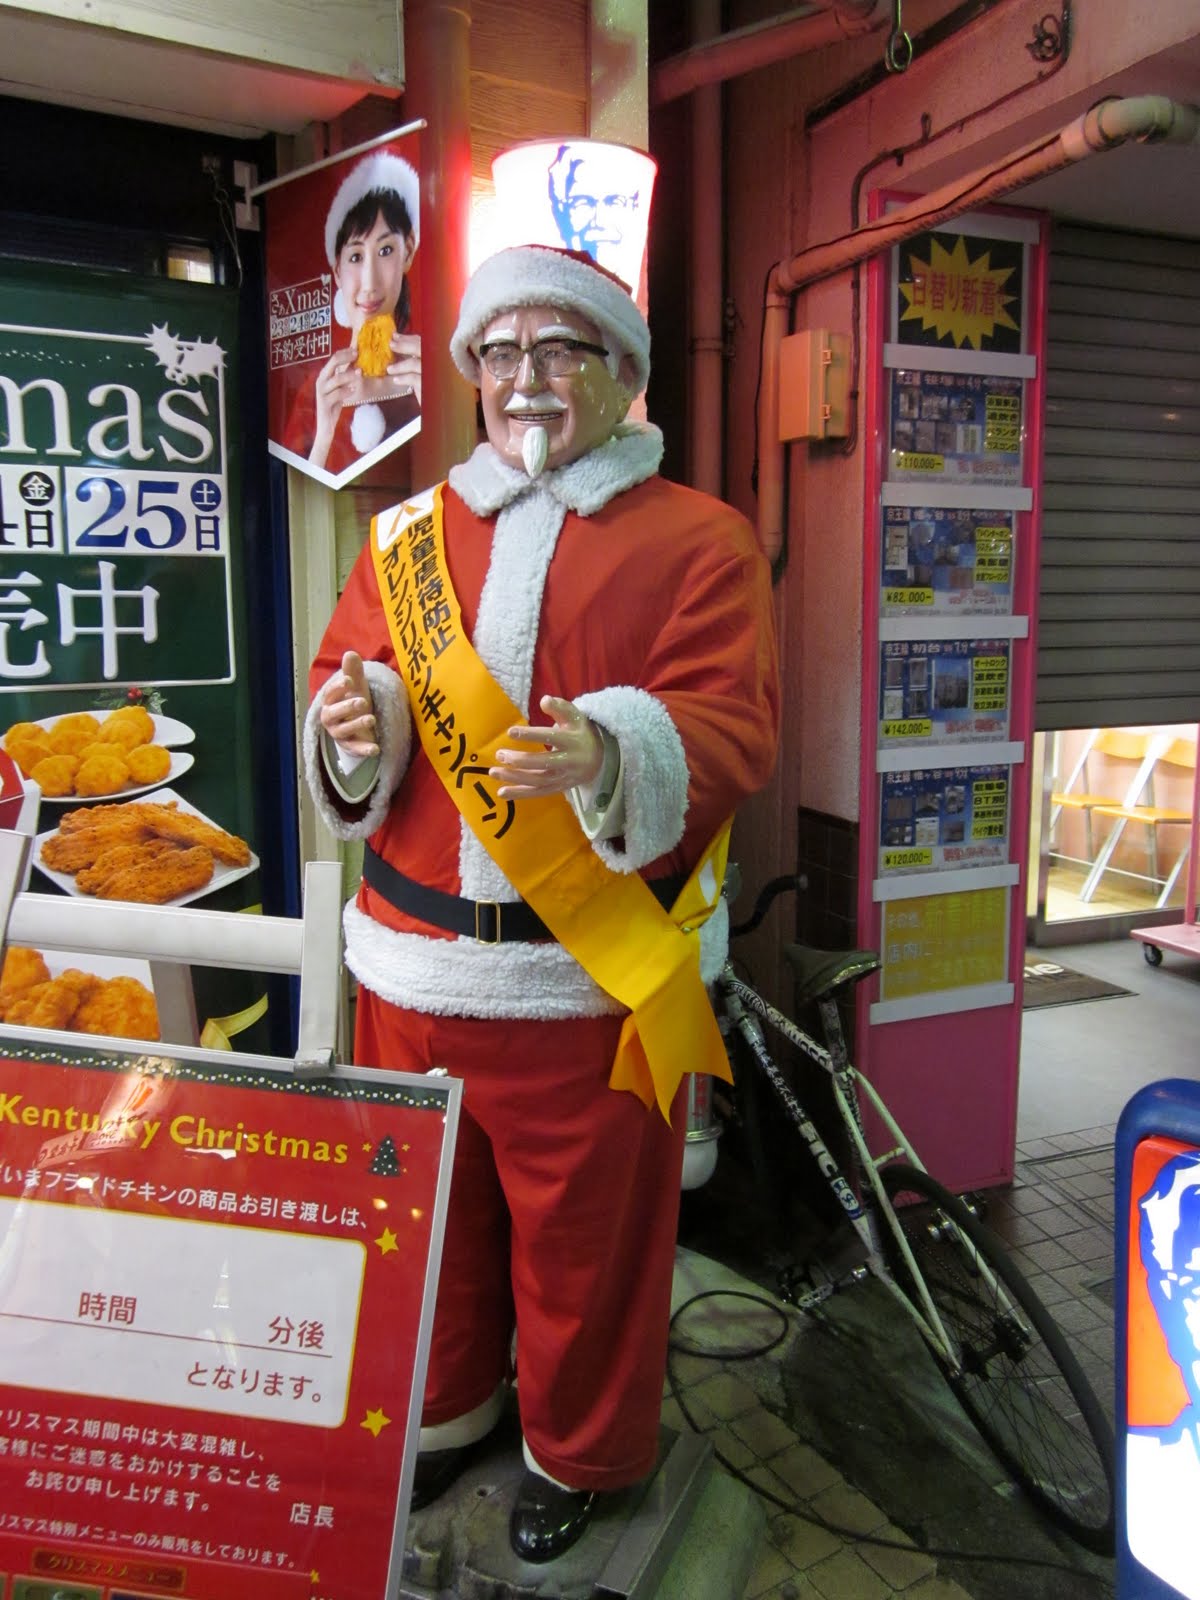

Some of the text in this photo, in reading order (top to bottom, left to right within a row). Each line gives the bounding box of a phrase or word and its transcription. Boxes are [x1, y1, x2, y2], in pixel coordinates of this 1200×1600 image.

[270, 330, 330, 364] 予約受付中
[407, 515, 456, 660] 児童虐待防止
[0, 1094, 160, 1150] Kentuky
[169, 1114, 349, 1164] Christmas
[0, 1163, 368, 1229] いまフライドチキンの商品お引き渡しは、
[78, 1291, 138, 1325] 時間
[268, 1316, 325, 1350] 分後
[187, 1361, 321, 1403] となります。
[0, 1407, 266, 1462] リスマス期間中は大変混雑し、
[25, 1468, 210, 1513] お詫び申し上げます。
[289, 1501, 334, 1528] 店長
